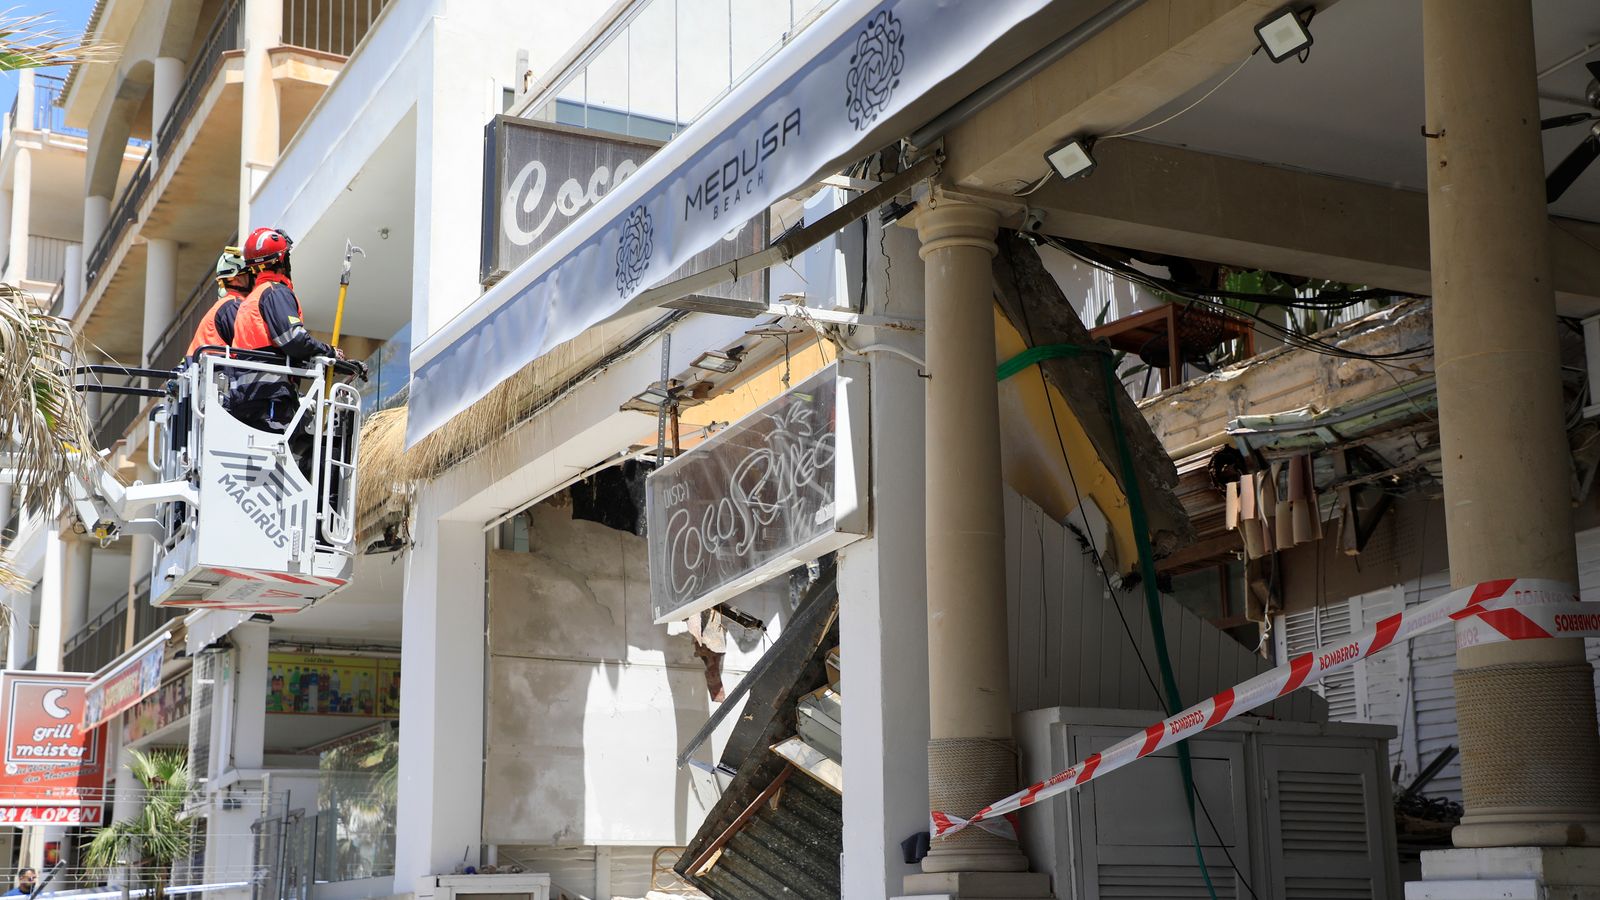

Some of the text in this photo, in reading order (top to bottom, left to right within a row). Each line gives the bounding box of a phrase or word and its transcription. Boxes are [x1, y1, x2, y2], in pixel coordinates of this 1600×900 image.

[685, 107, 801, 221] MEDUSA
[713, 168, 764, 220] BEACH
[217, 473, 289, 548] MAGIRUS
[1319, 642, 1360, 670] BOMBEROS
[33, 724, 73, 741] grill
[1169, 710, 1204, 735] BOMBEROS
[16, 742, 87, 757] meister
[41, 808, 97, 822] OPEN
